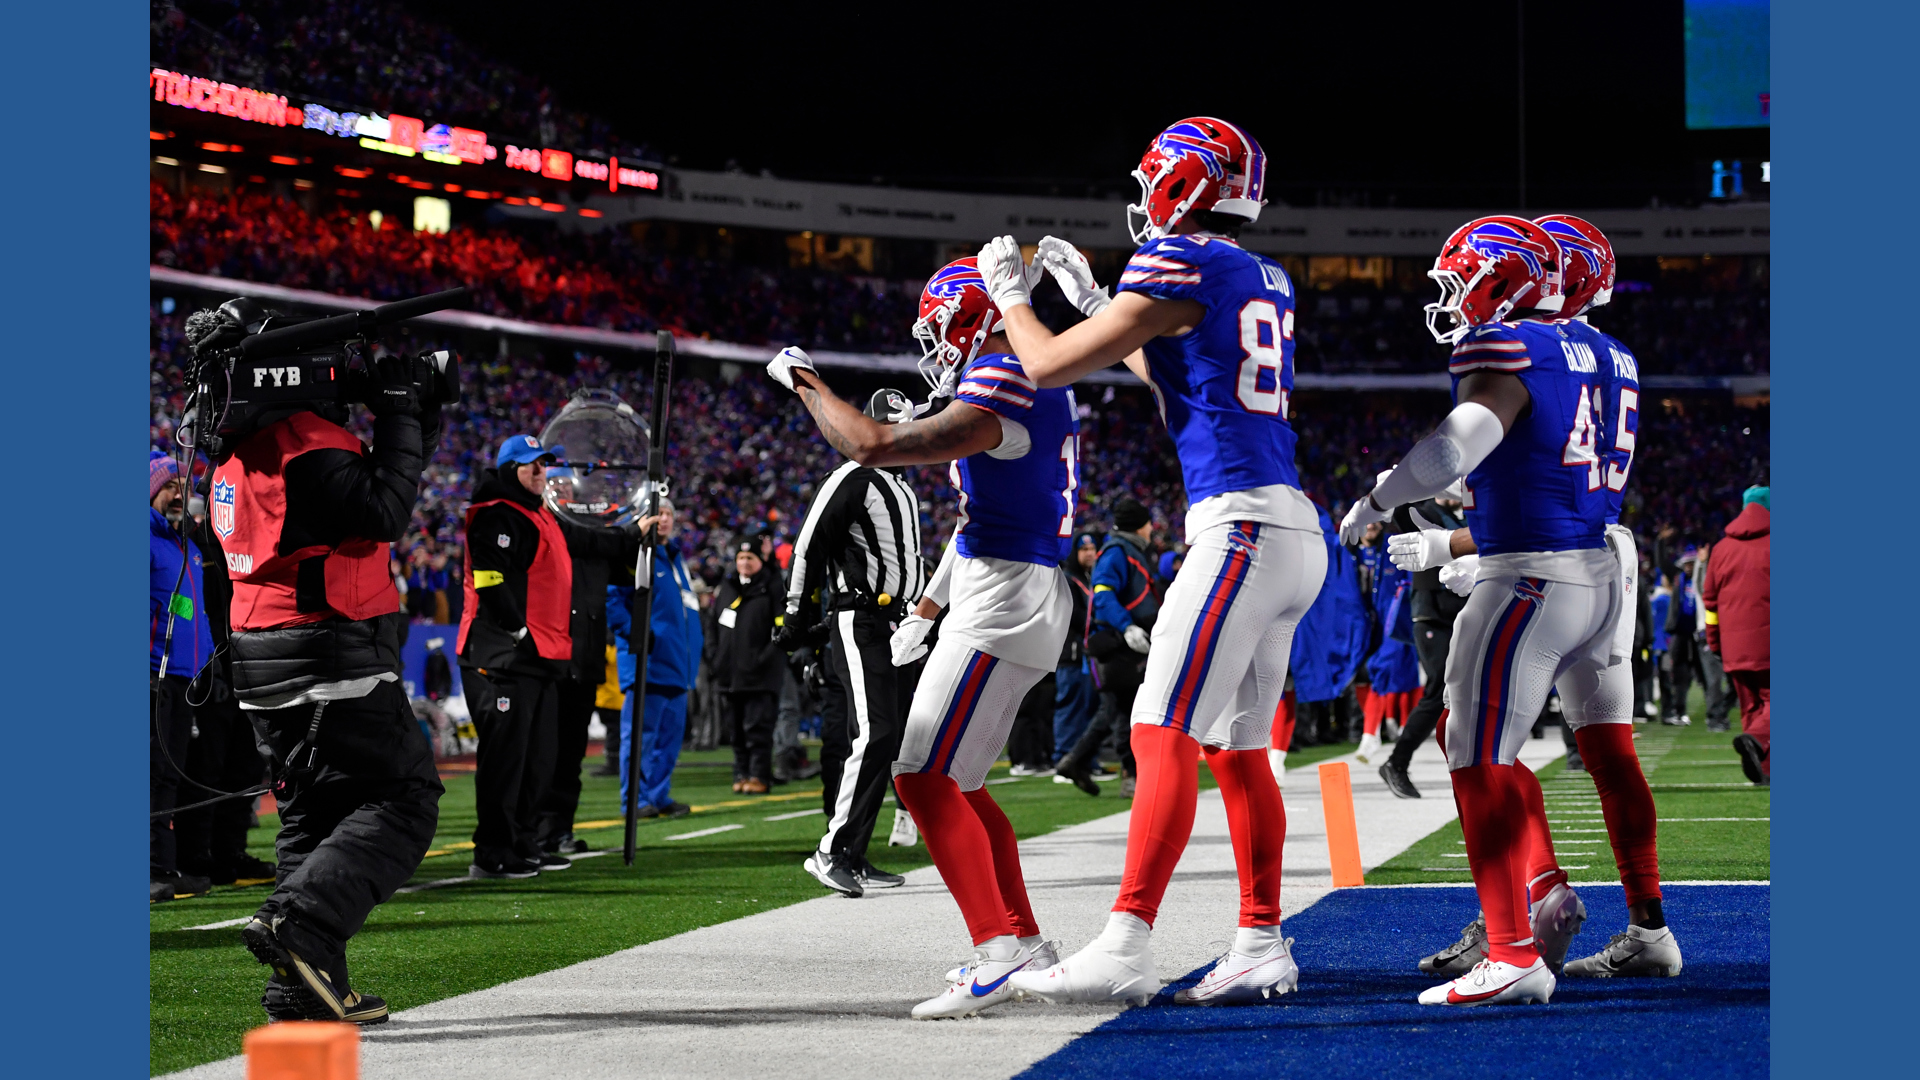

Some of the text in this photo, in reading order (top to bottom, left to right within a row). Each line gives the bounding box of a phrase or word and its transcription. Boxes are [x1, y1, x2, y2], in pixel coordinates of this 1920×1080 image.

[152, 68, 289, 127] TOUCHDOWN
[253, 366, 301, 387] FYB
[1607, 386, 1639, 493] 5
[1057, 433, 1081, 537] 1
[216, 502, 233, 530] NFL
